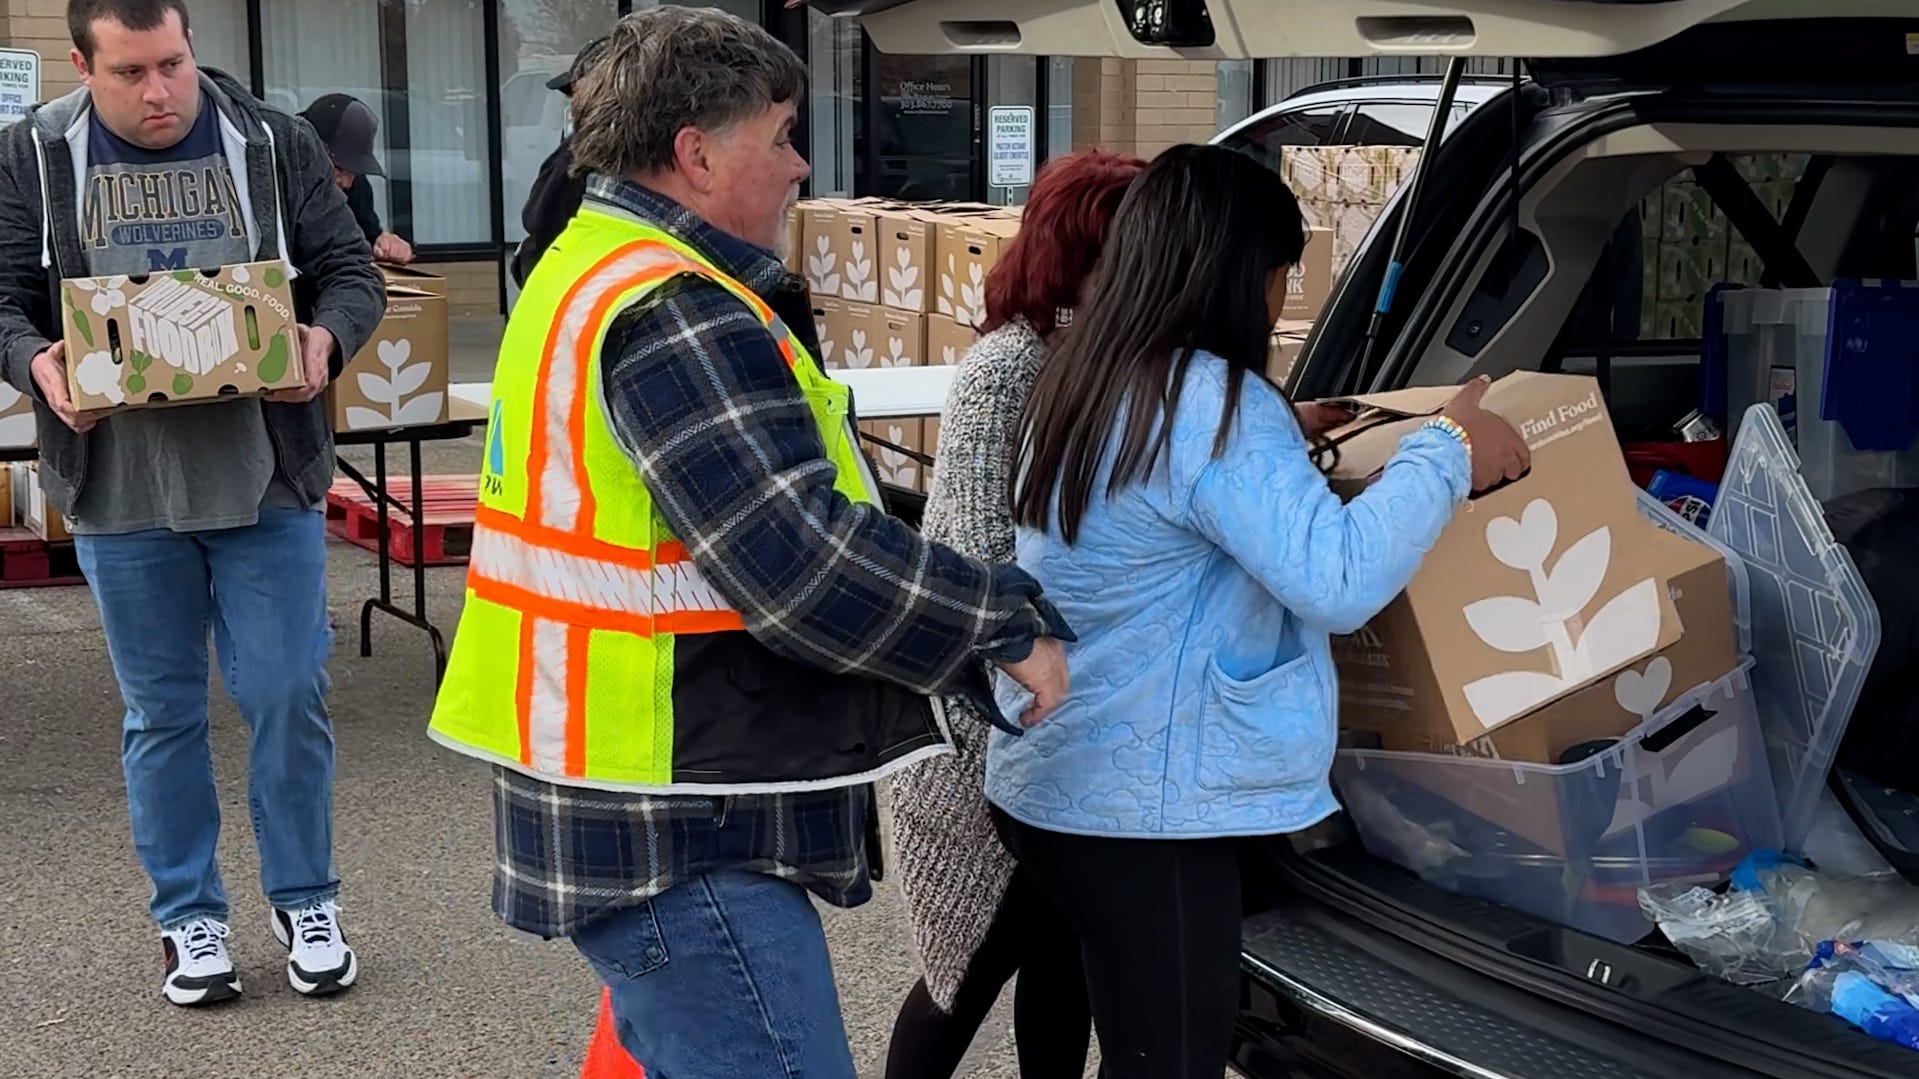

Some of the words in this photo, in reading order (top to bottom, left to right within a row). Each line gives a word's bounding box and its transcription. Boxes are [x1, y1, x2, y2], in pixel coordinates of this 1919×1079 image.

[900, 81, 925, 93] Office
[926, 82, 951, 91] Hours
[995, 115, 1028, 123] RESERVED
[997, 125, 1026, 133] PARKING
[81, 166, 247, 251] MICHIGAN
[118, 221, 218, 244] WOLVERINES
[146, 247, 188, 272] M
[193, 273, 225, 292] REAL.
[226, 283, 261, 299] GOOD.
[262, 294, 290, 321] FOOD.
[128, 304, 200, 375] FOOD
[1520, 409, 1557, 440] Find
[1557, 392, 1598, 422] Food
